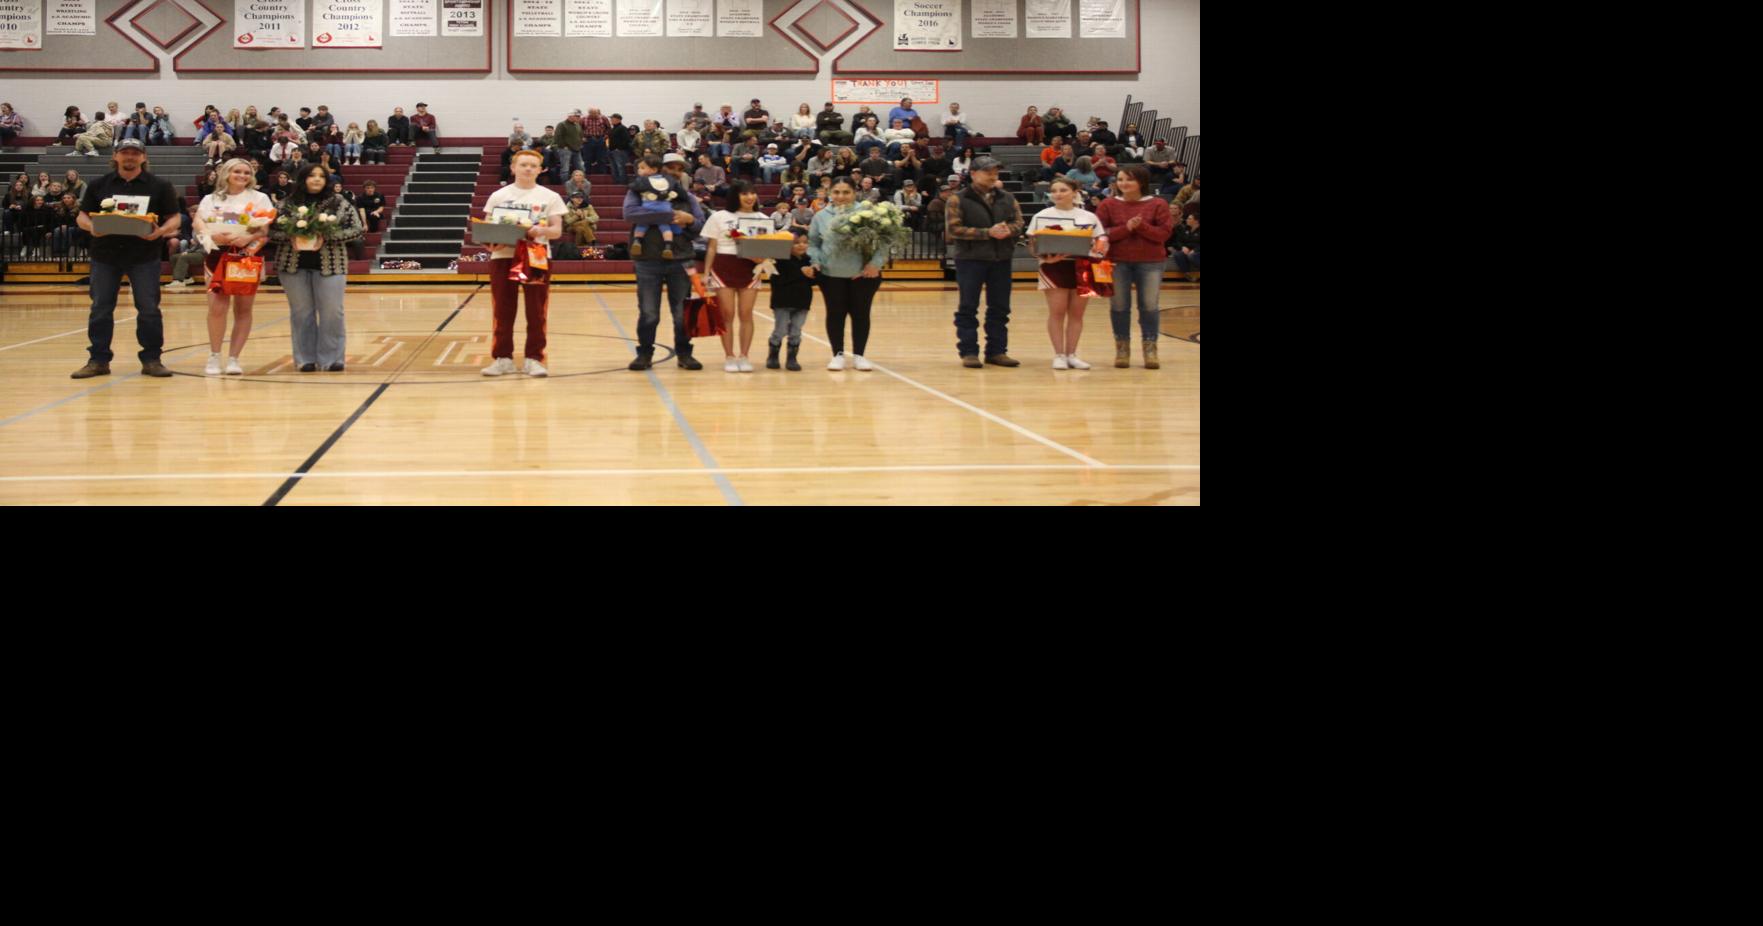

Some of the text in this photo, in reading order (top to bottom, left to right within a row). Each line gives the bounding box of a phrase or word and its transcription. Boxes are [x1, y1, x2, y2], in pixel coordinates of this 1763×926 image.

[328, 4, 366, 12] Country
[244, 12, 295, 20] Champions
[322, 13, 374, 21] Champions
[259, 22, 280, 30] 2011
